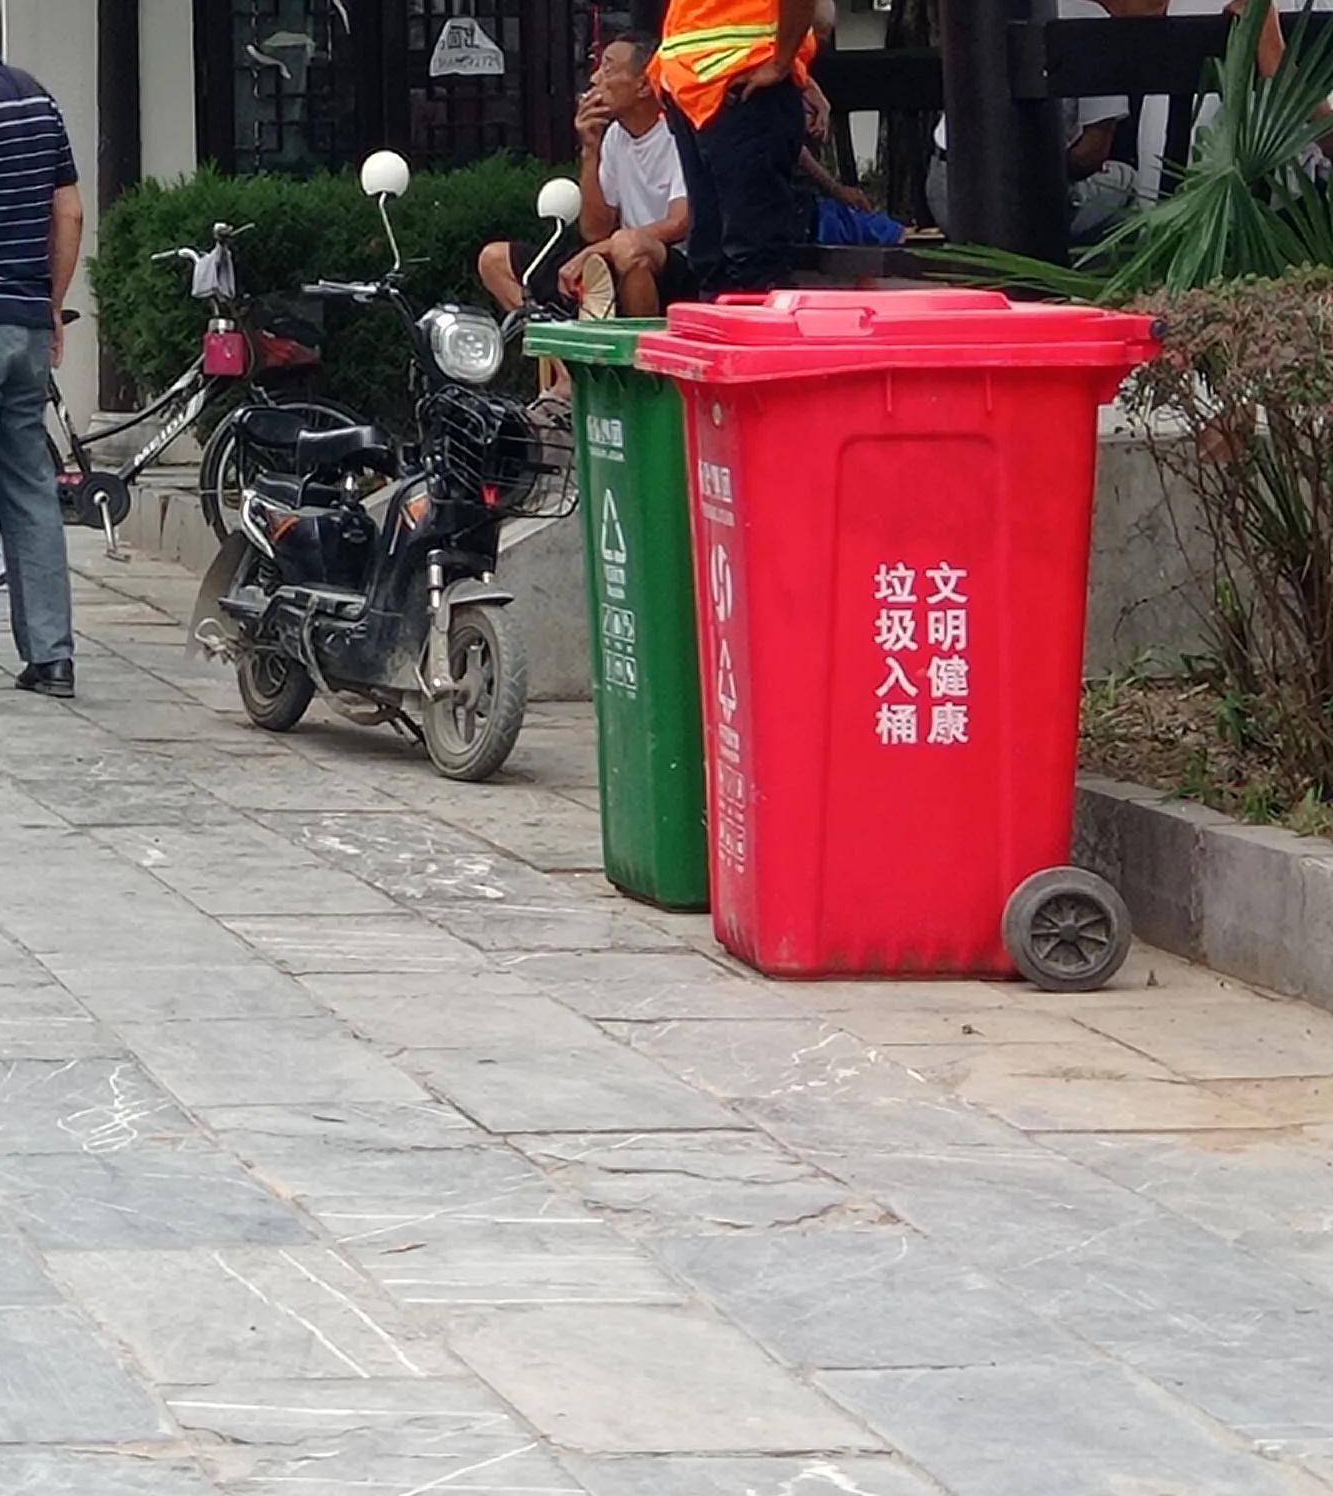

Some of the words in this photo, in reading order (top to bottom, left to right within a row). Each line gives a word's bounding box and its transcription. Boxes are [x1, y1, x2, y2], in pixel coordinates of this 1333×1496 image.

[874, 562, 919, 744] 垃圾入桶
[926, 561, 969, 744] 文明健康
